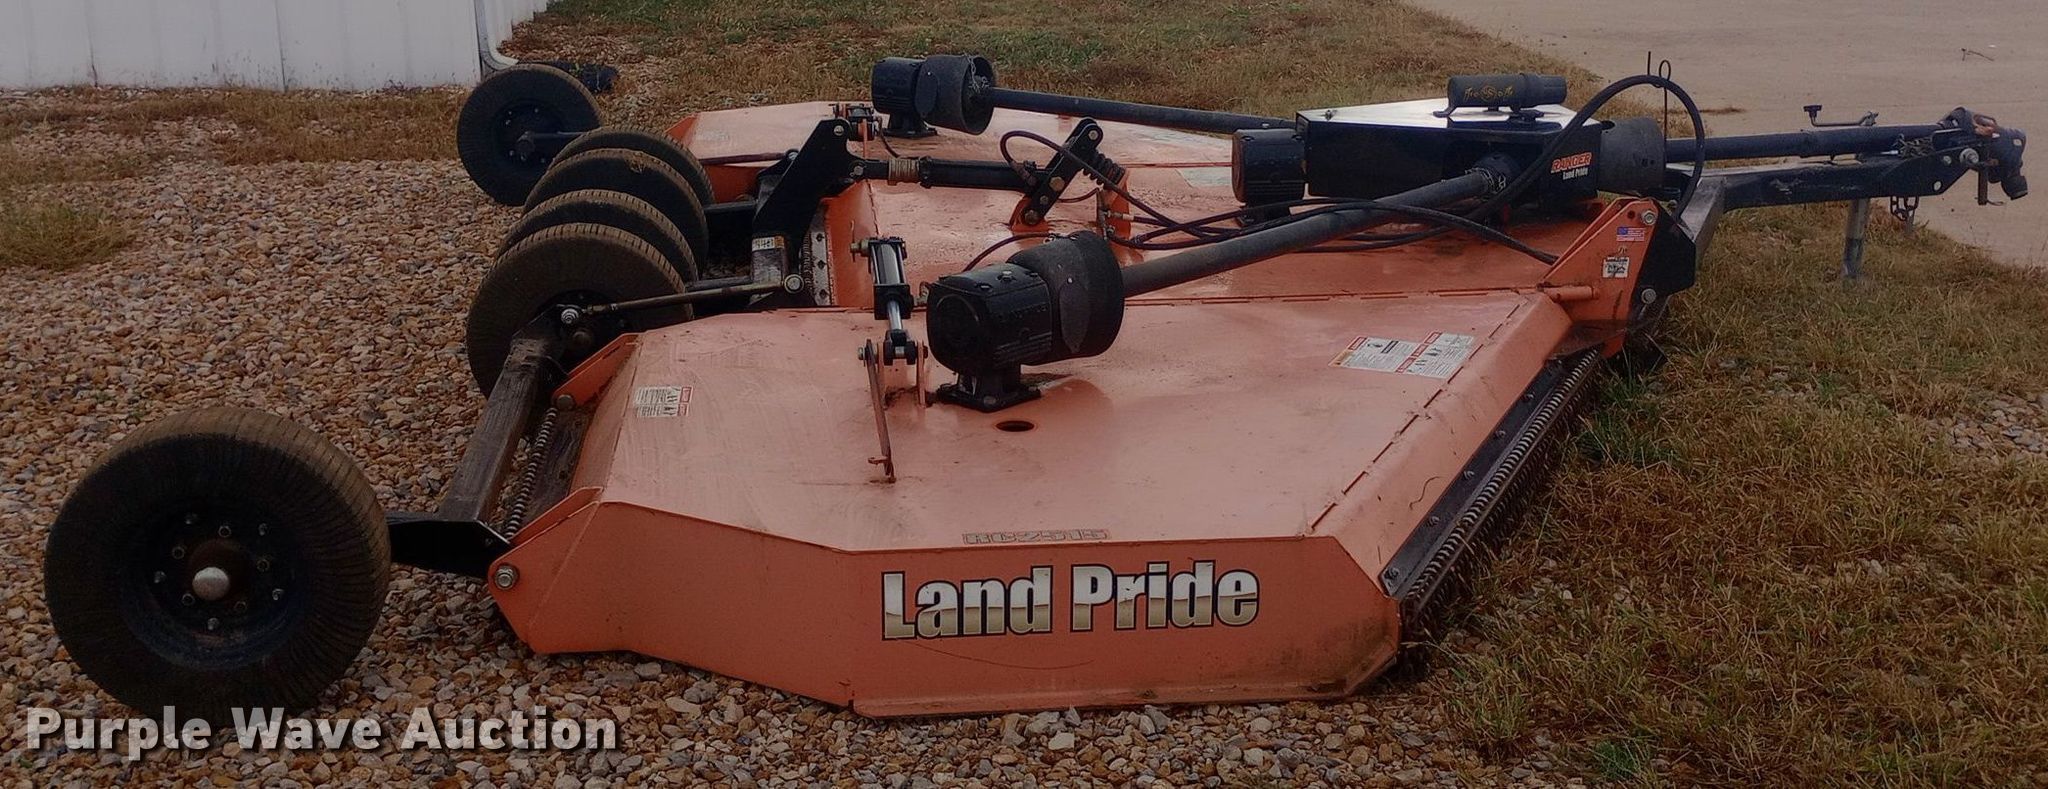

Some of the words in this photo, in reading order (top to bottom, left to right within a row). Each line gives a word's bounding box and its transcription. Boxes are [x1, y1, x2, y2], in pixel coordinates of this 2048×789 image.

[1550, 152, 1592, 173] RANGER
[881, 565, 1053, 640] Land
[1070, 560, 1260, 632] Pride
